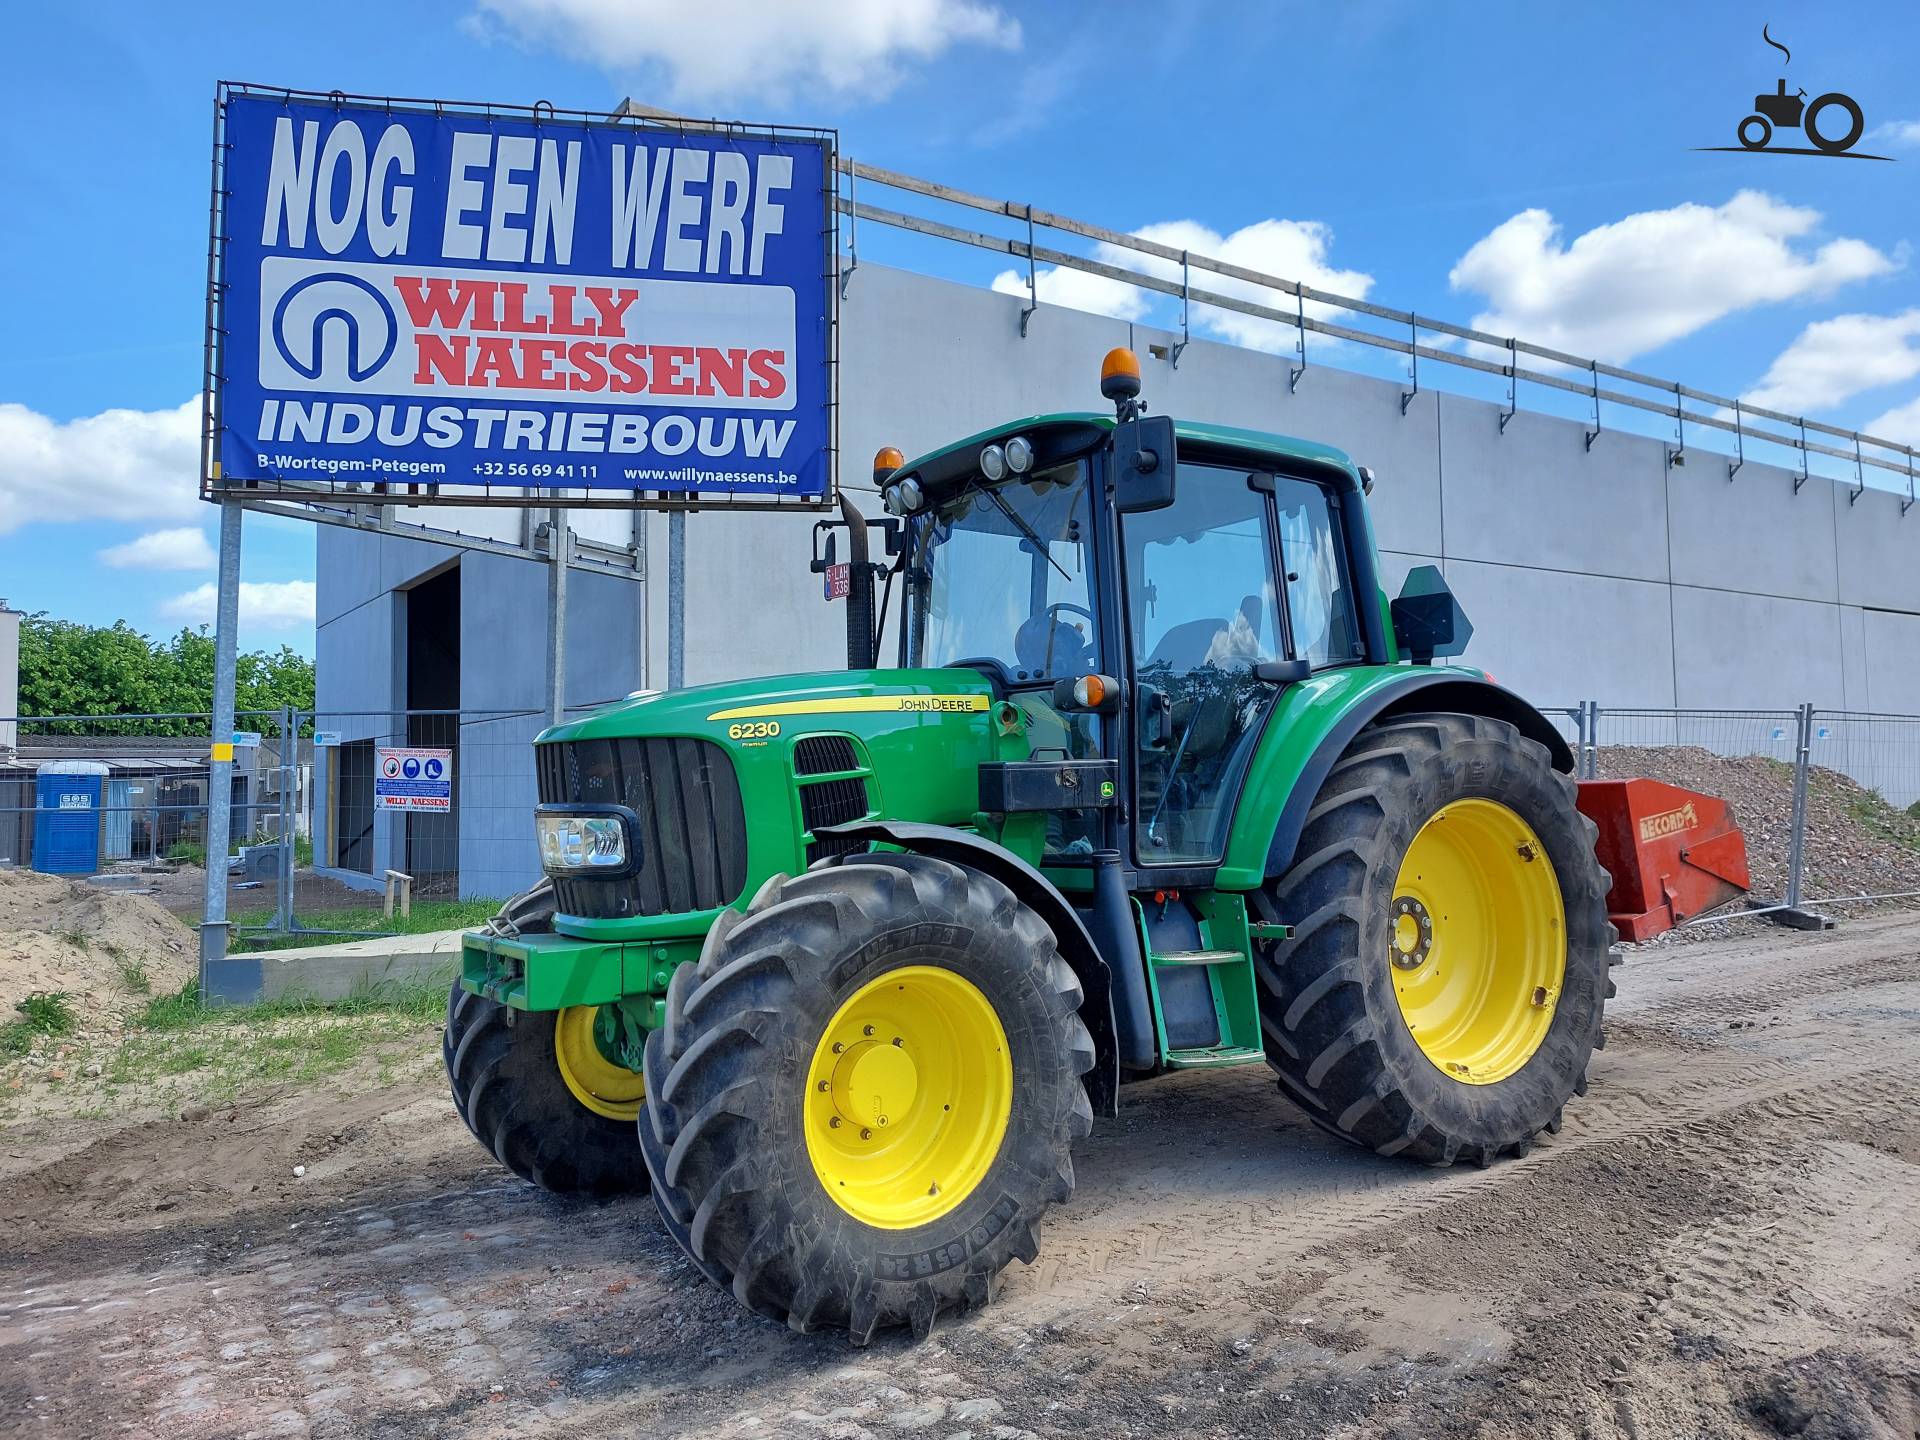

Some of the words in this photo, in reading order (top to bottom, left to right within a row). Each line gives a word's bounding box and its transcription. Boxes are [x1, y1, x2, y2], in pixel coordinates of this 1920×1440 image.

[261, 117, 415, 258] NOG
[441, 131, 582, 265] EEN
[612, 144, 794, 276] WERF
[394, 276, 639, 338] WILLY
[414, 333, 786, 399] NAESSENS
[257, 399, 797, 459] INDUSTRIEBOUW
[257, 454, 446, 476] B-Wortegem-Petegem
[472, 462, 504, 475] +32
[508, 463, 528, 476] 56
[531, 464, 552, 477] 69
[555, 464, 574, 477] 41
[580, 465, 597, 478] 11
[623, 467, 797, 485] www.willynaessens.be
[898, 698, 930, 710] JOHN
[931, 698, 973, 710] DEERE
[728, 721, 781, 739] 6230
[385, 797, 408, 805] WILLY
[411, 798, 449, 806] NAESSENS
[1640, 811, 1685, 840] RECORD
[880, 1257, 911, 1278] 24
[913, 1253, 934, 1275] R
